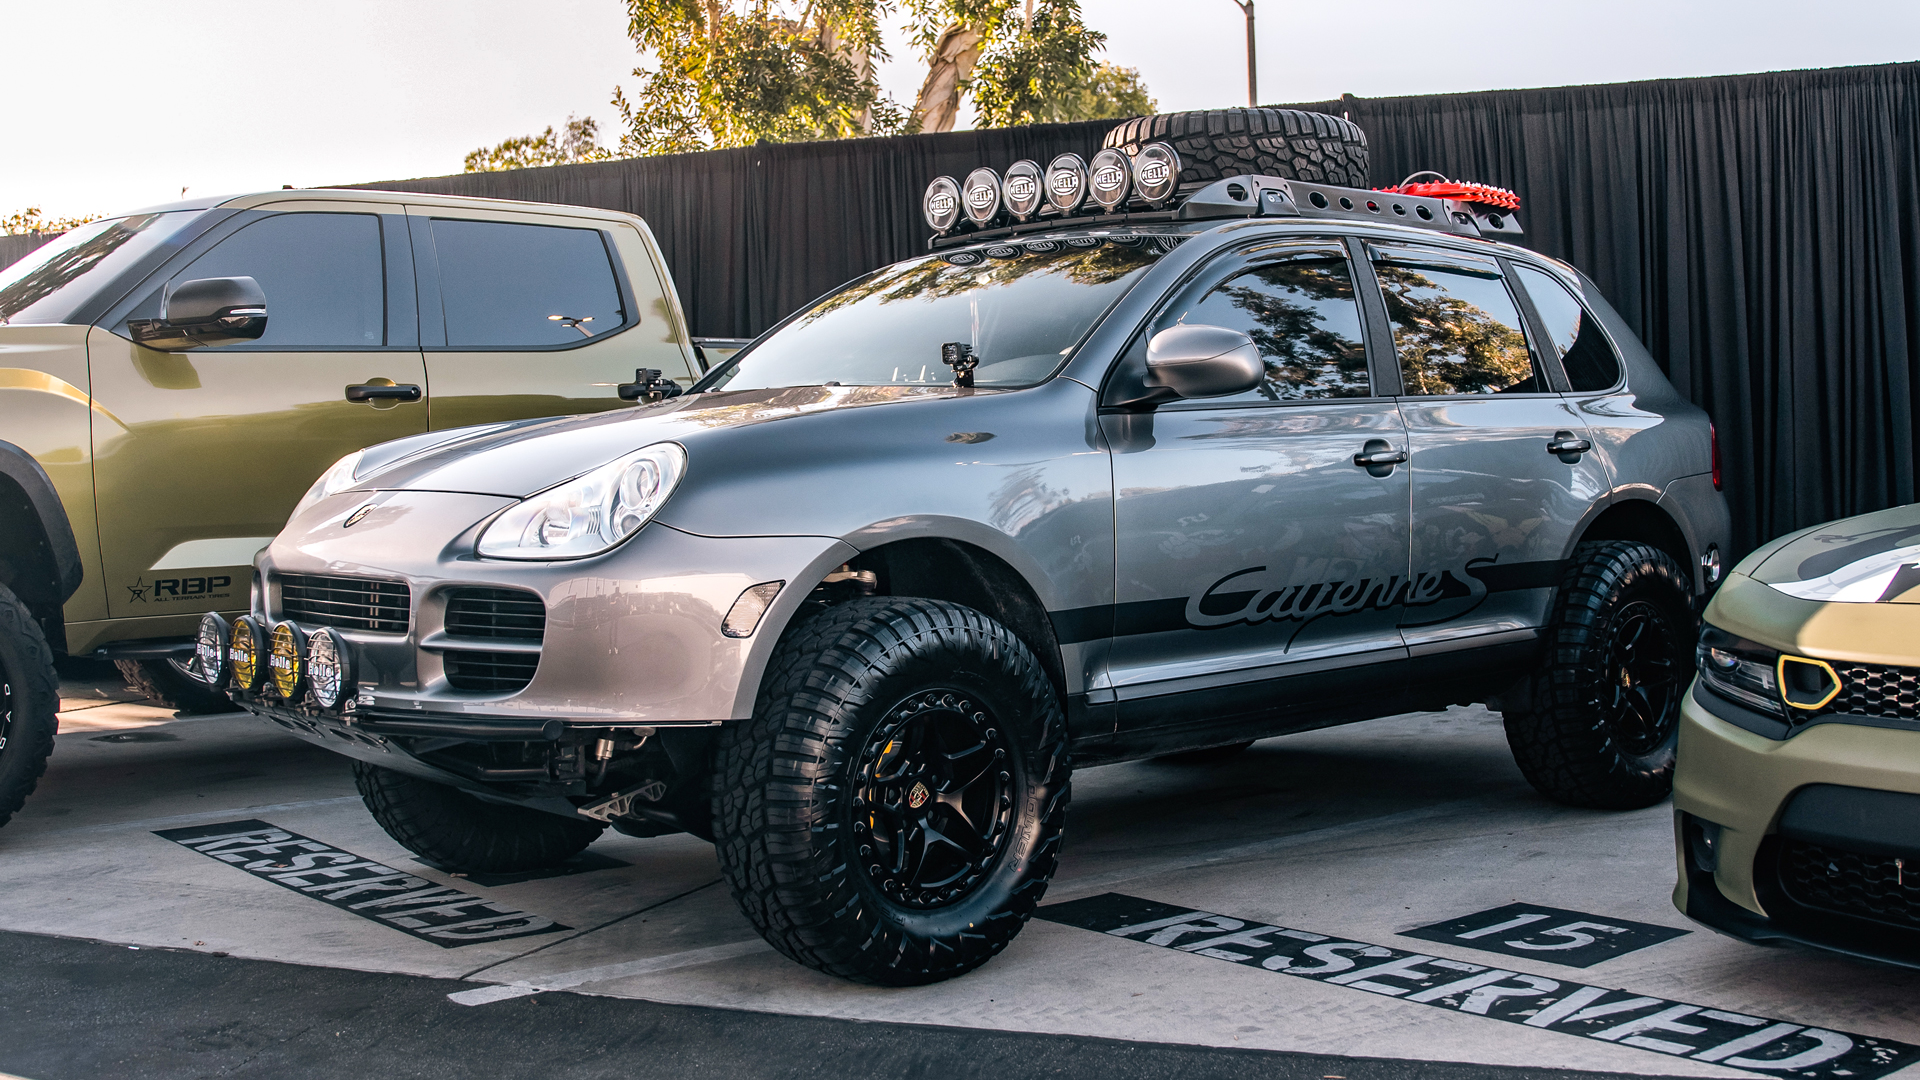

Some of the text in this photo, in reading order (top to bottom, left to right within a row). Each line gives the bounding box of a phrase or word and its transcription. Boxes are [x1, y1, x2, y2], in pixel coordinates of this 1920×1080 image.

[1096, 171, 1123, 184] HELLA
[1142, 166, 1169, 179] HELLA
[1010, 182, 1035, 194] HELLA
[1053, 176, 1078, 188] HELLA
[970, 189, 993, 201] HELLA
[931, 198, 953, 209] HELLA
[154, 576, 231, 596] RBP
[1185, 566, 1443, 654] Cayenne
[270, 654, 291, 670] Hella
[177, 828, 555, 939] RESERVED
[1455, 913, 1629, 951] 15
[1105, 911, 1853, 1069] RESERVED
